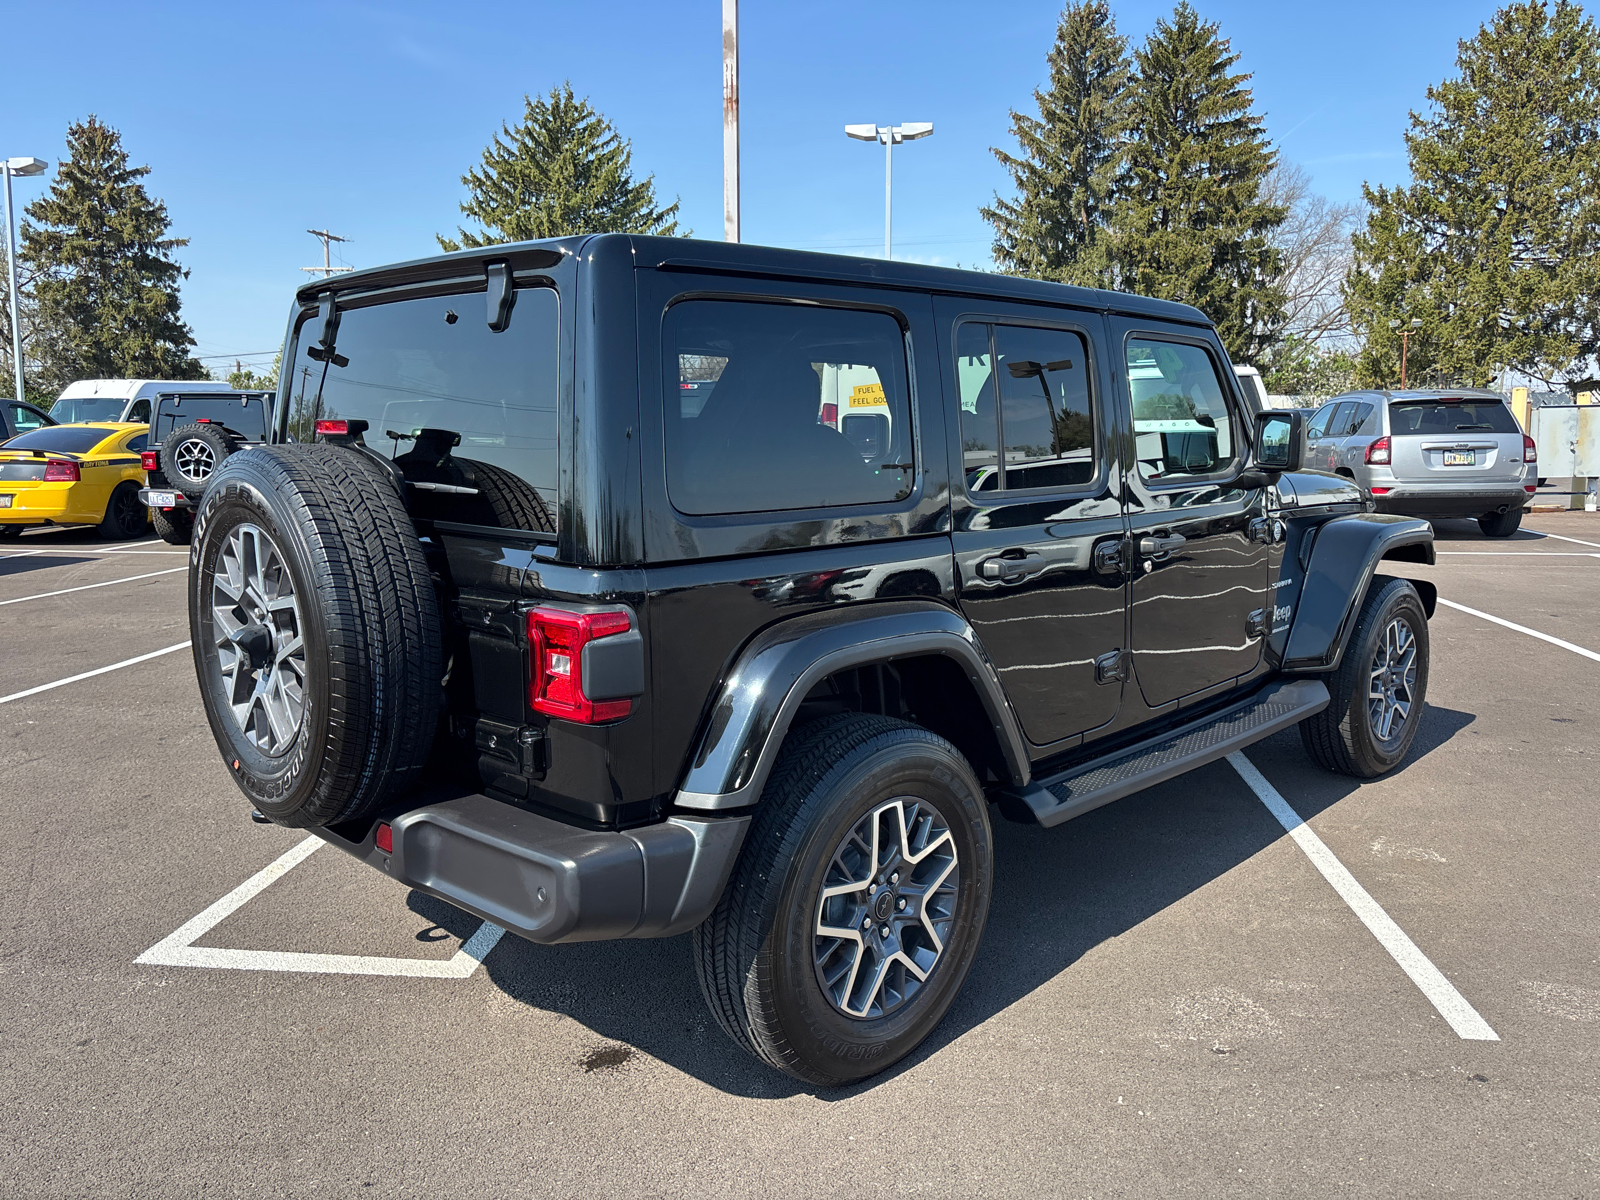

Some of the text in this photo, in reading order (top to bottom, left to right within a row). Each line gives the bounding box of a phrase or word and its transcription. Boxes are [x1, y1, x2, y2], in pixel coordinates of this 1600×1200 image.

[857, 386, 876, 394] FUEL
[852, 397, 871, 405] FEEL
[83, 460, 109, 468] DAYTONA
[1272, 604, 1291, 622] Jeep
